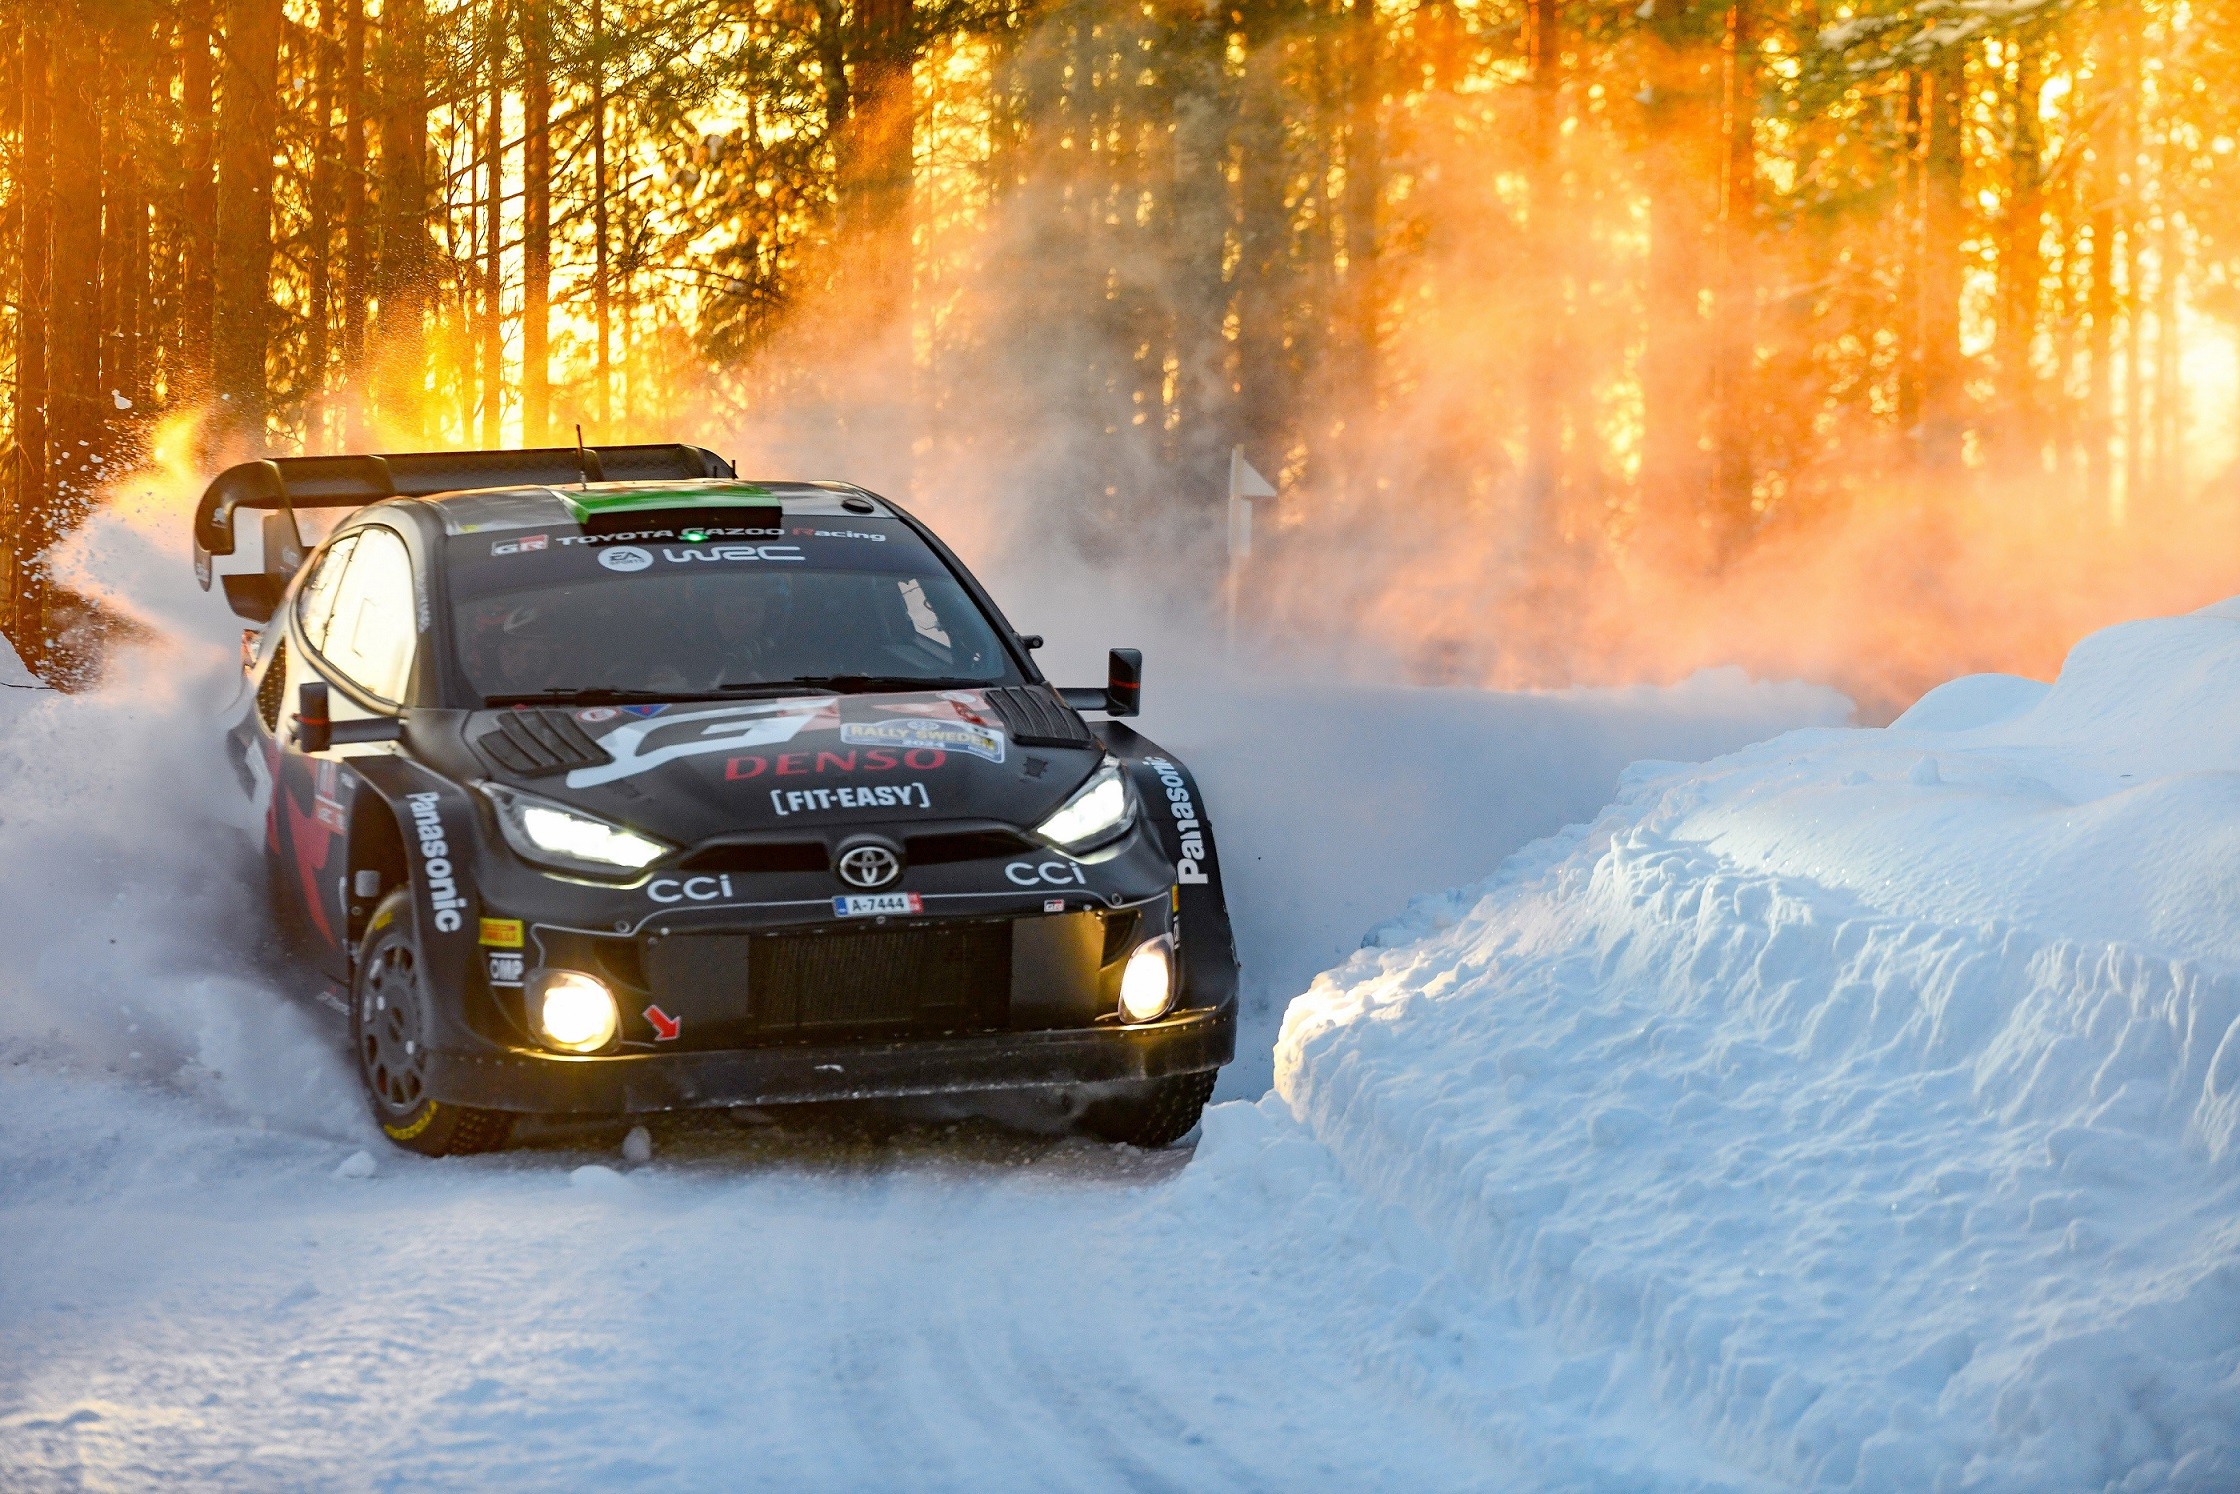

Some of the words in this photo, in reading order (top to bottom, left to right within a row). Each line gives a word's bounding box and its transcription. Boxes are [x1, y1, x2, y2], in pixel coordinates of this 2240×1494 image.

[555, 529, 674, 546] TOYOTA
[677, 528, 785, 540] GAZOO
[792, 528, 886, 541] Racing
[491, 539, 548, 556] GR
[610, 551, 642, 560] EA
[663, 546, 805, 562] WRC
[851, 725, 908, 738] RALLY
[725, 748, 947, 781] DENSO
[1142, 756, 1208, 884] Panasonic
[406, 792, 467, 932] Panasonic
[852, 898, 904, 911] A-7444
